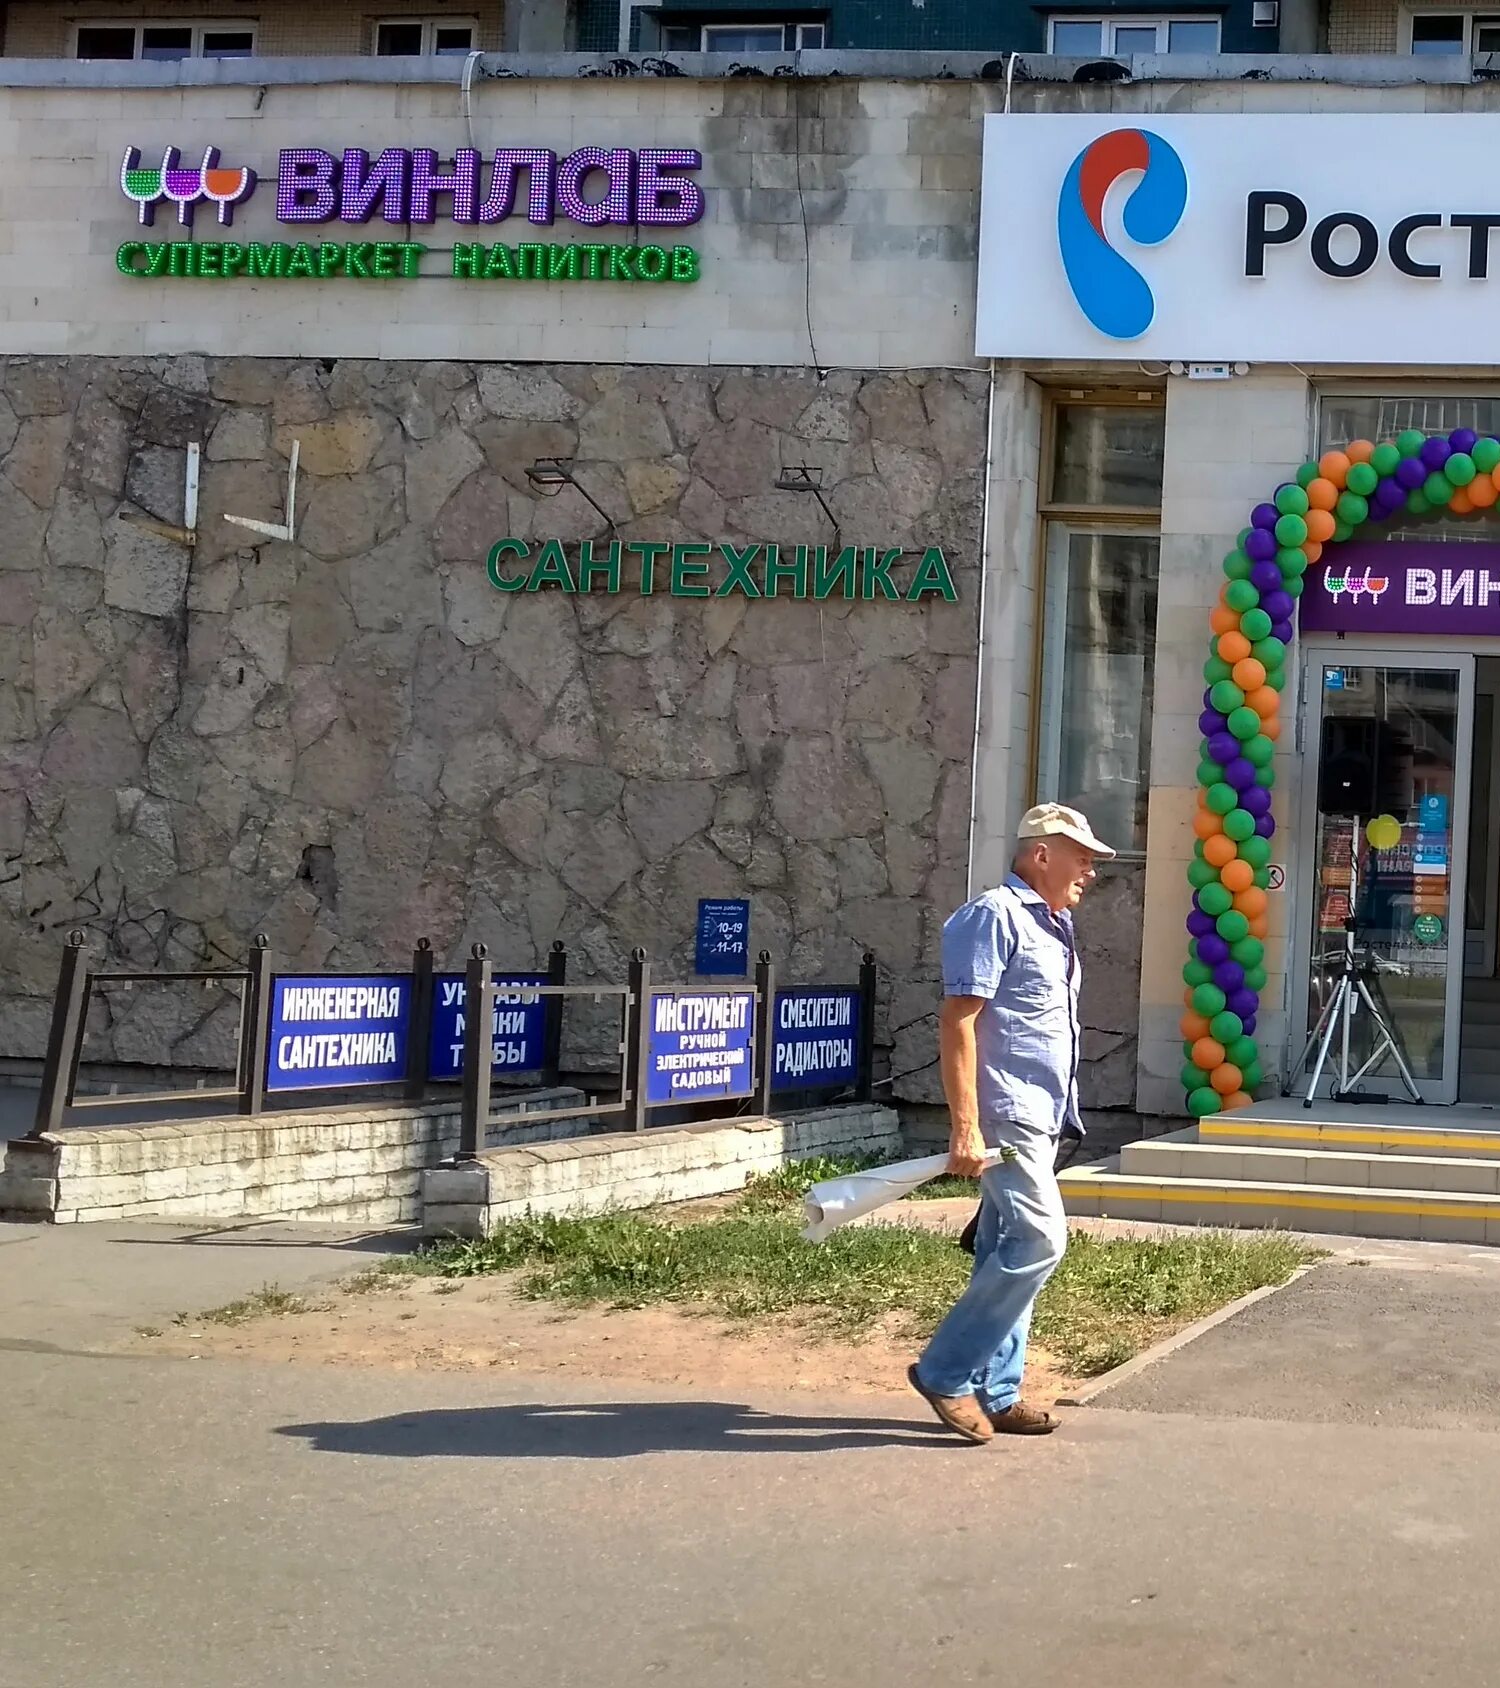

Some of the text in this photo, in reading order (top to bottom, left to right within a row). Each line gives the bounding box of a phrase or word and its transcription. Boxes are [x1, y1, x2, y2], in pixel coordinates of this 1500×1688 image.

[275, 147, 704, 227] ВИНЛАБ
[115, 240, 701, 283] СУПЕРМАРКЕТ НАПИТКОВ
[486, 537, 959, 602] САНТЕХНИКА
[718, 922, 743, 933] 10-19
[717, 941, 744, 953] 11-17
[282, 986, 400, 1021] ИНЖЕНЕРНАЯ
[442, 982, 541, 1006] УНАЗЫ
[655, 996, 749, 1032] ИНСТРУМЕНТ
[780, 997, 851, 1029] СМЕСИТЕЛИ
[278, 1032, 396, 1070] САНТЕХНИКА
[450, 1041, 527, 1067] ТБЫ
[679, 1031, 727, 1050] РУЧНОЙ
[656, 1048, 744, 1071] ЭЛЕКТРИЧЕСКИЙ
[776, 1038, 852, 1077] РАДИАТОРЫ
[671, 1067, 731, 1089] САДОВЫЙ
